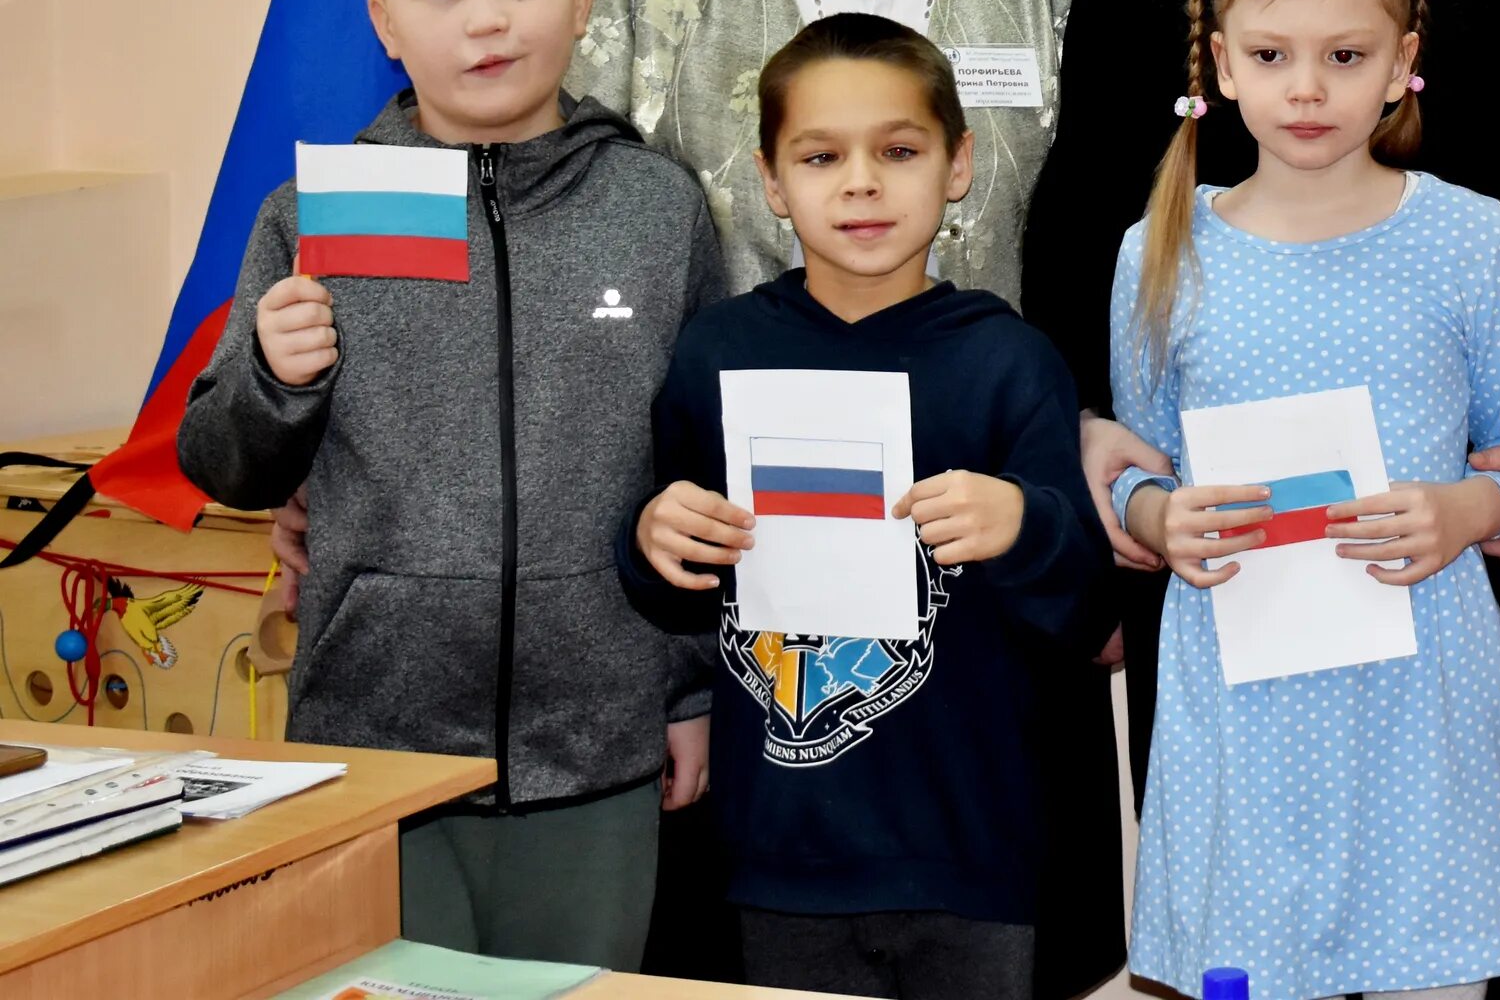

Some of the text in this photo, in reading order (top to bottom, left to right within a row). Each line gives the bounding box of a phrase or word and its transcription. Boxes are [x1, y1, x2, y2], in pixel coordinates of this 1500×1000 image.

[958, 68, 1022, 76] ПОРФИРЬЕВА
[986, 80, 1029, 88] Петровна
[765, 737, 797, 761] MIENS
[799, 727, 853, 760] NUNQUAM
[850, 670, 923, 719] TITILLANDUS
